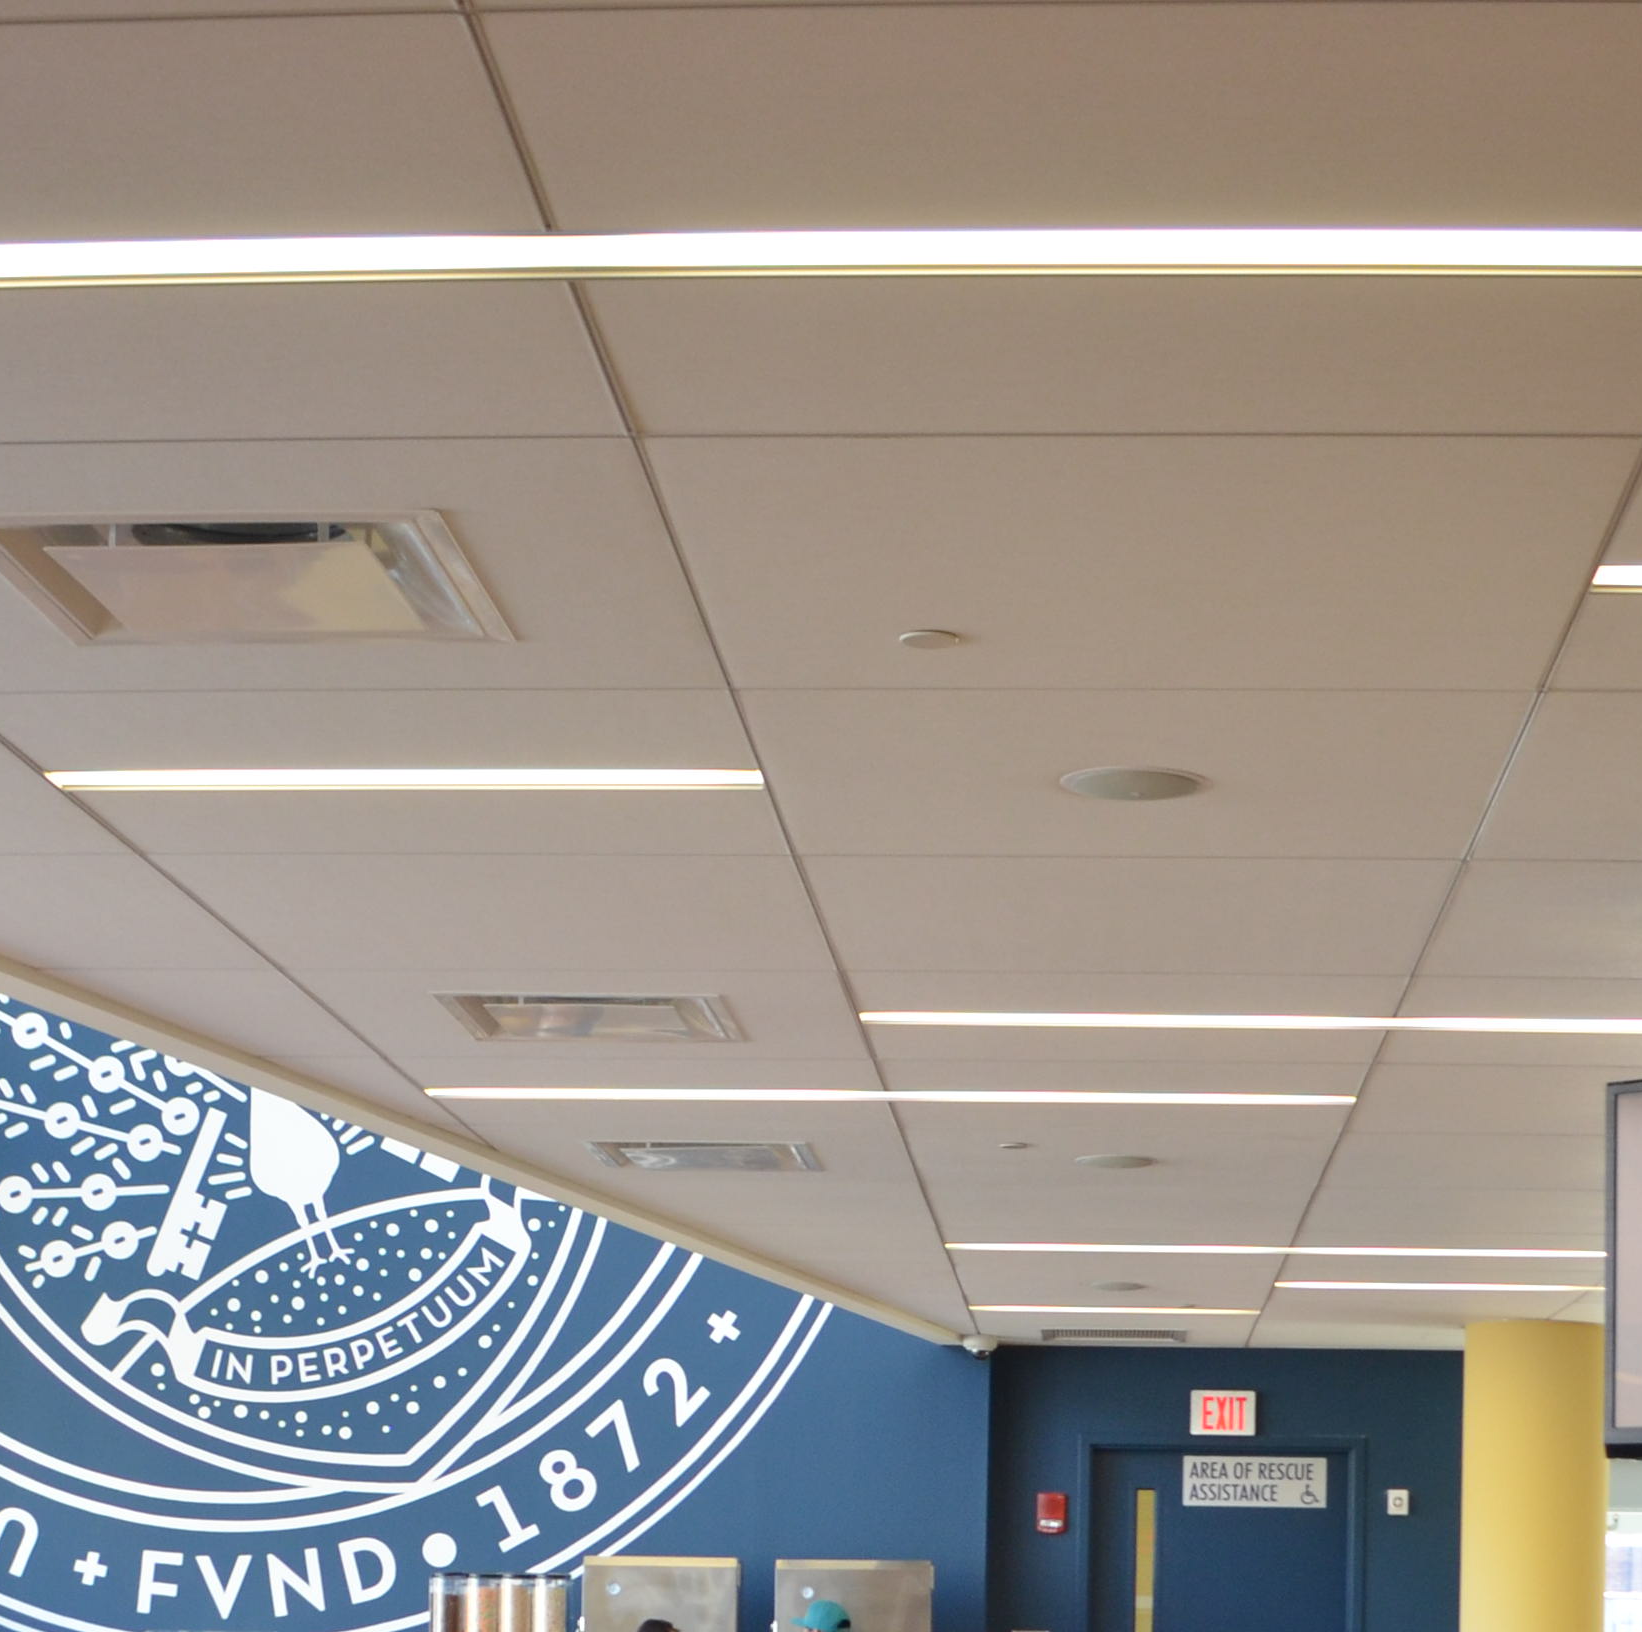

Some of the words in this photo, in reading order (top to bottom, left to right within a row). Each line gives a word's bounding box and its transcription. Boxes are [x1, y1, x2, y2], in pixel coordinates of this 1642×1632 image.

[210, 1348, 254, 1385] IN
[269, 1247, 505, 1385] PERPETUUM
[1201, 1396, 1247, 1431] EXIT
[136, 1536, 397, 1620] FVND
[475, 1357, 711, 1553] 1872
[1189, 1461, 1229, 1479] AREA
[1233, 1462, 1253, 1480] OF
[1258, 1462, 1314, 1481] RESCUE
[1189, 1483, 1278, 1502] ASSISTANCE
